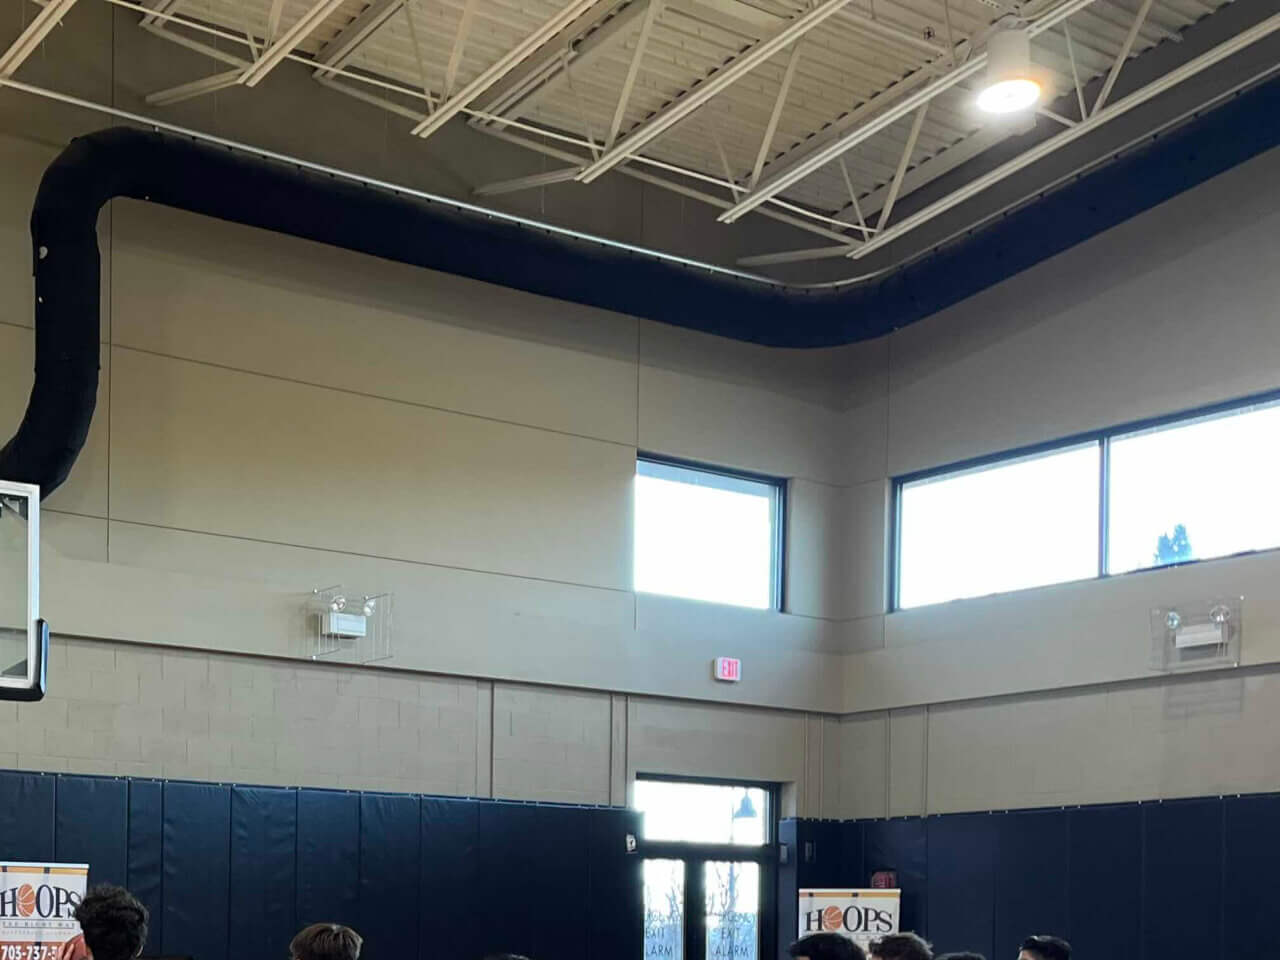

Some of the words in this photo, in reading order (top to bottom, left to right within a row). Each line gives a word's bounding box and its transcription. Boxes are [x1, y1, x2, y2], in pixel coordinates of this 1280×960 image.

[721, 660, 738, 677] EXIT
[805, 905, 893, 933] HOOPS
[721, 927, 740, 939] EXIT
[715, 945, 749, 957] ALARM
